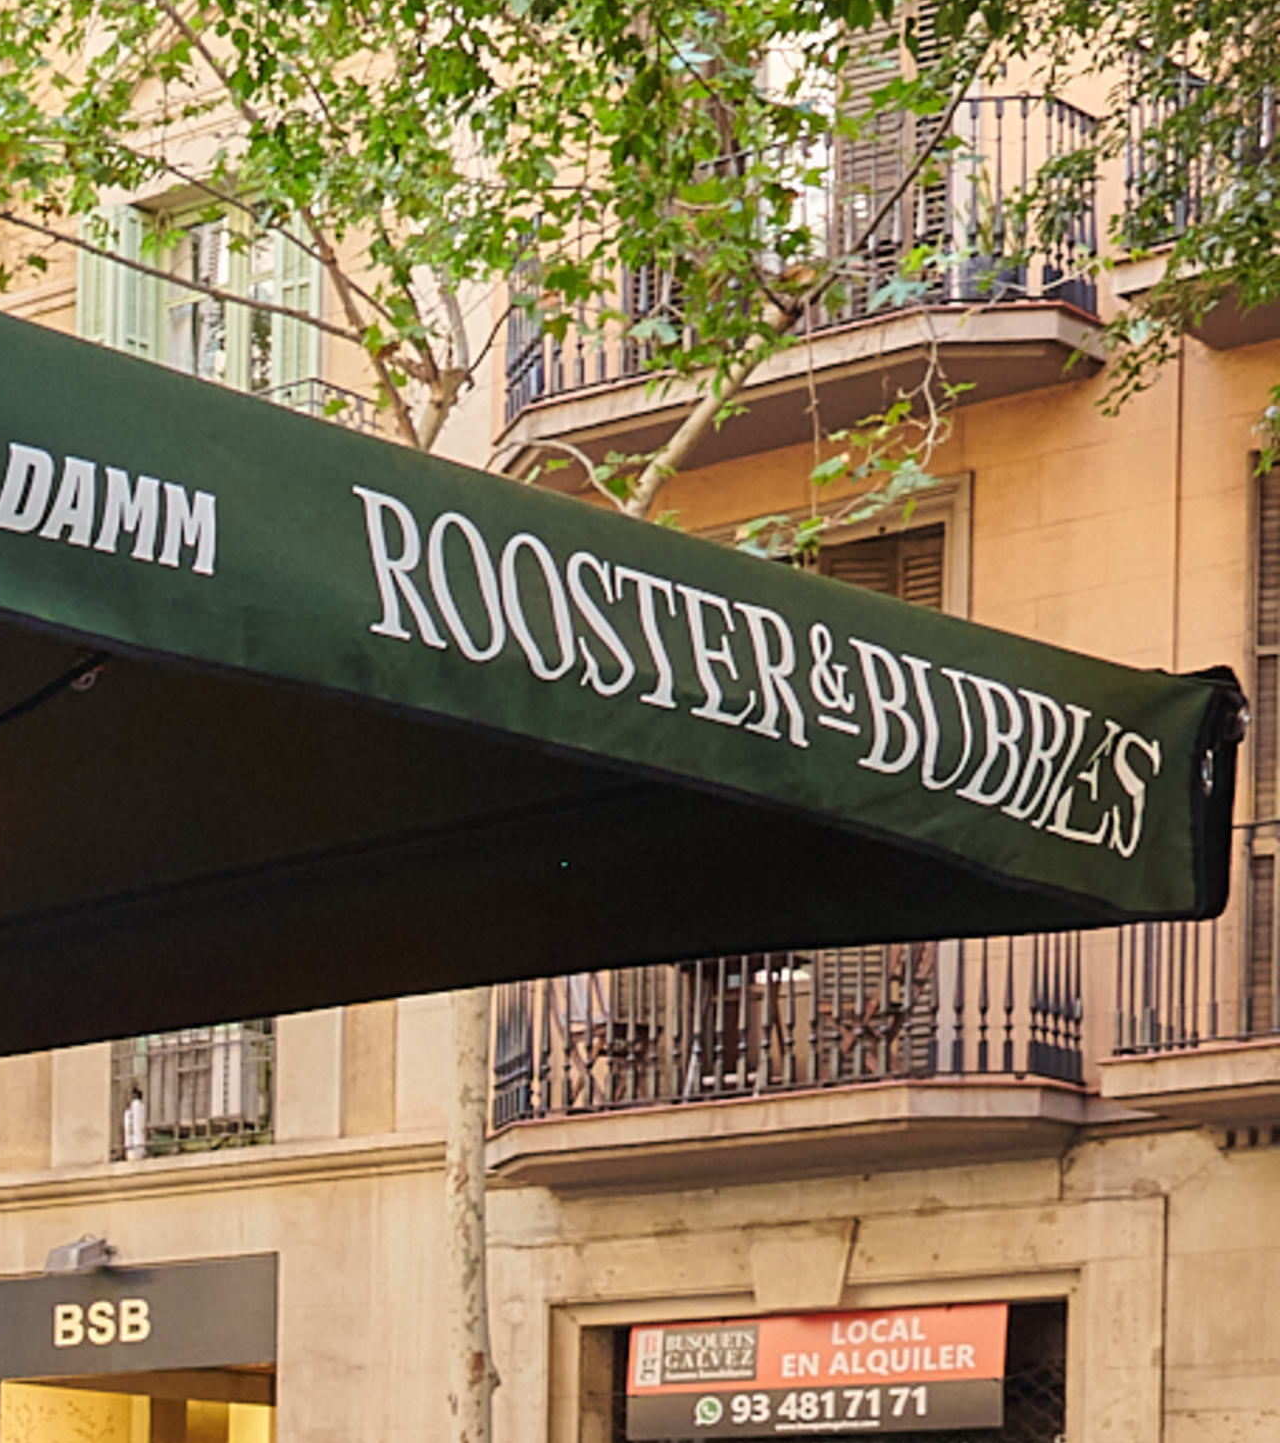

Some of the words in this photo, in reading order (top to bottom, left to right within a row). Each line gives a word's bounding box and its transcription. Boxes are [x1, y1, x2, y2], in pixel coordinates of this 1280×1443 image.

[351, 484, 810, 749] ROOSTER
[53, 1298, 152, 1348] BSB
[831, 1317, 926, 1345] LOCAL
[781, 1353, 820, 1378] EN
[828, 1344, 976, 1377] ALQUILER
[730, 1393, 771, 1424] 93
[777, 1391, 836, 1421] 481
[842, 1388, 881, 1418] 71
[888, 1386, 928, 1416] 71
